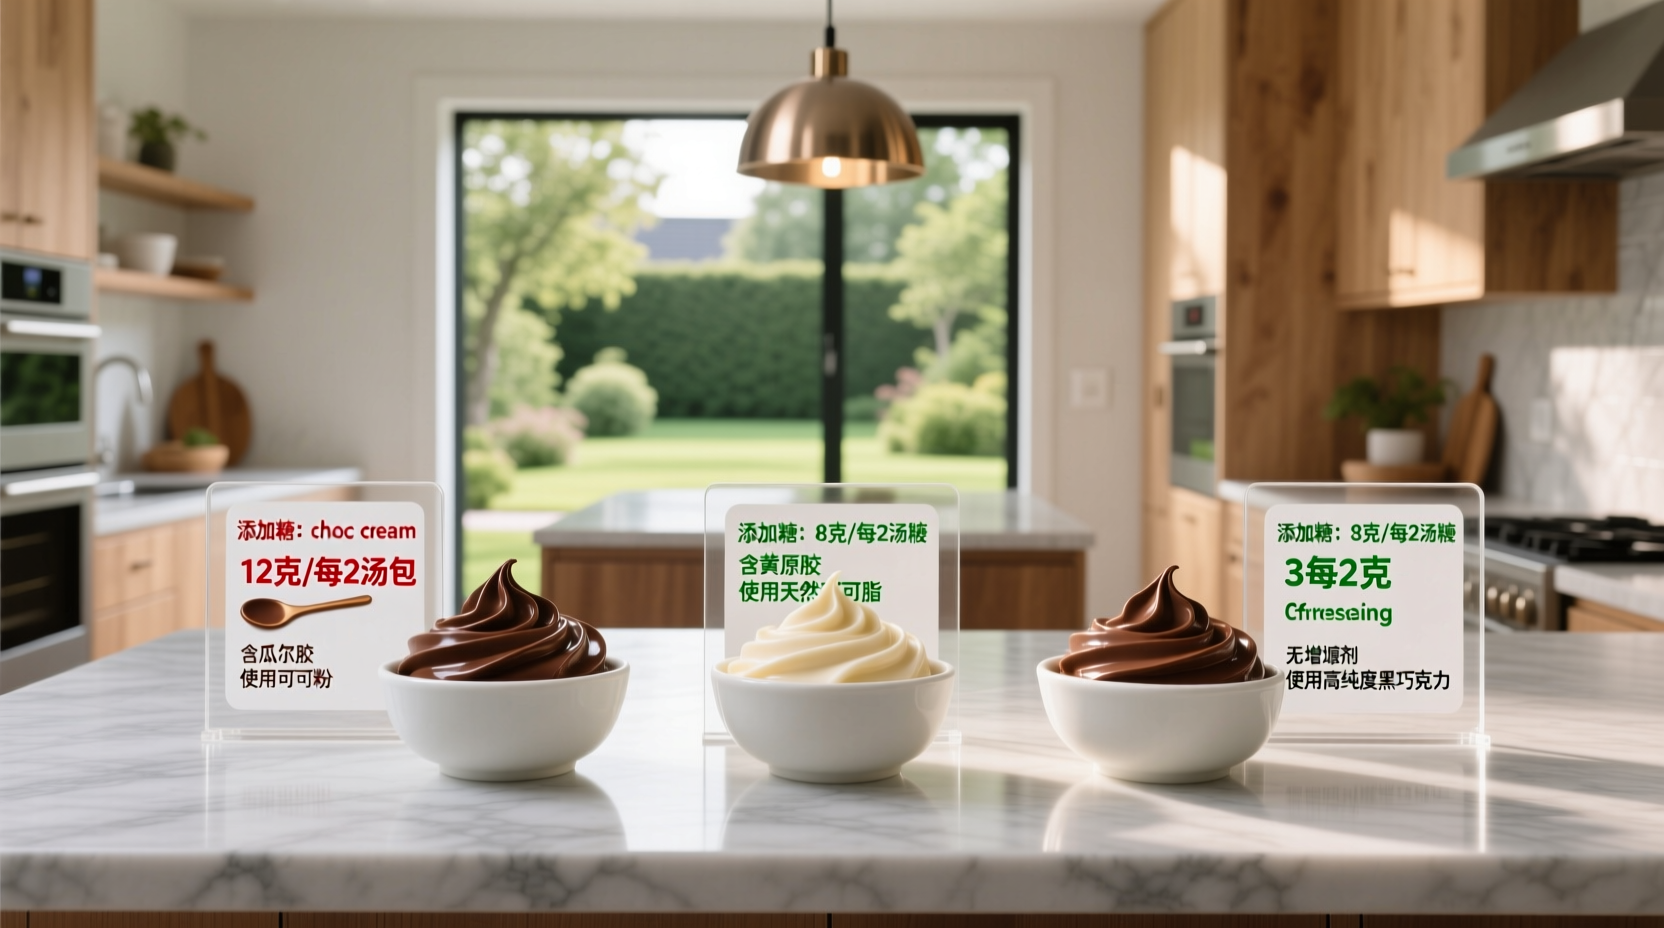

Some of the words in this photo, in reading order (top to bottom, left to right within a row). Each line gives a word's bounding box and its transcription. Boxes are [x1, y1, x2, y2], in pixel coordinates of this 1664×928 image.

[310, 519, 355, 541] choc
[359, 524, 416, 541] cream
[240, 555, 417, 588] 12克/每2汤包
[738, 552, 822, 576] 含黄原胶
[1284, 554, 1392, 591] 3每2克
[738, 579, 883, 603] 使用天然可脂
[240, 643, 314, 664] 含瓜尔胶
[239, 667, 334, 689] 使用可可粉
